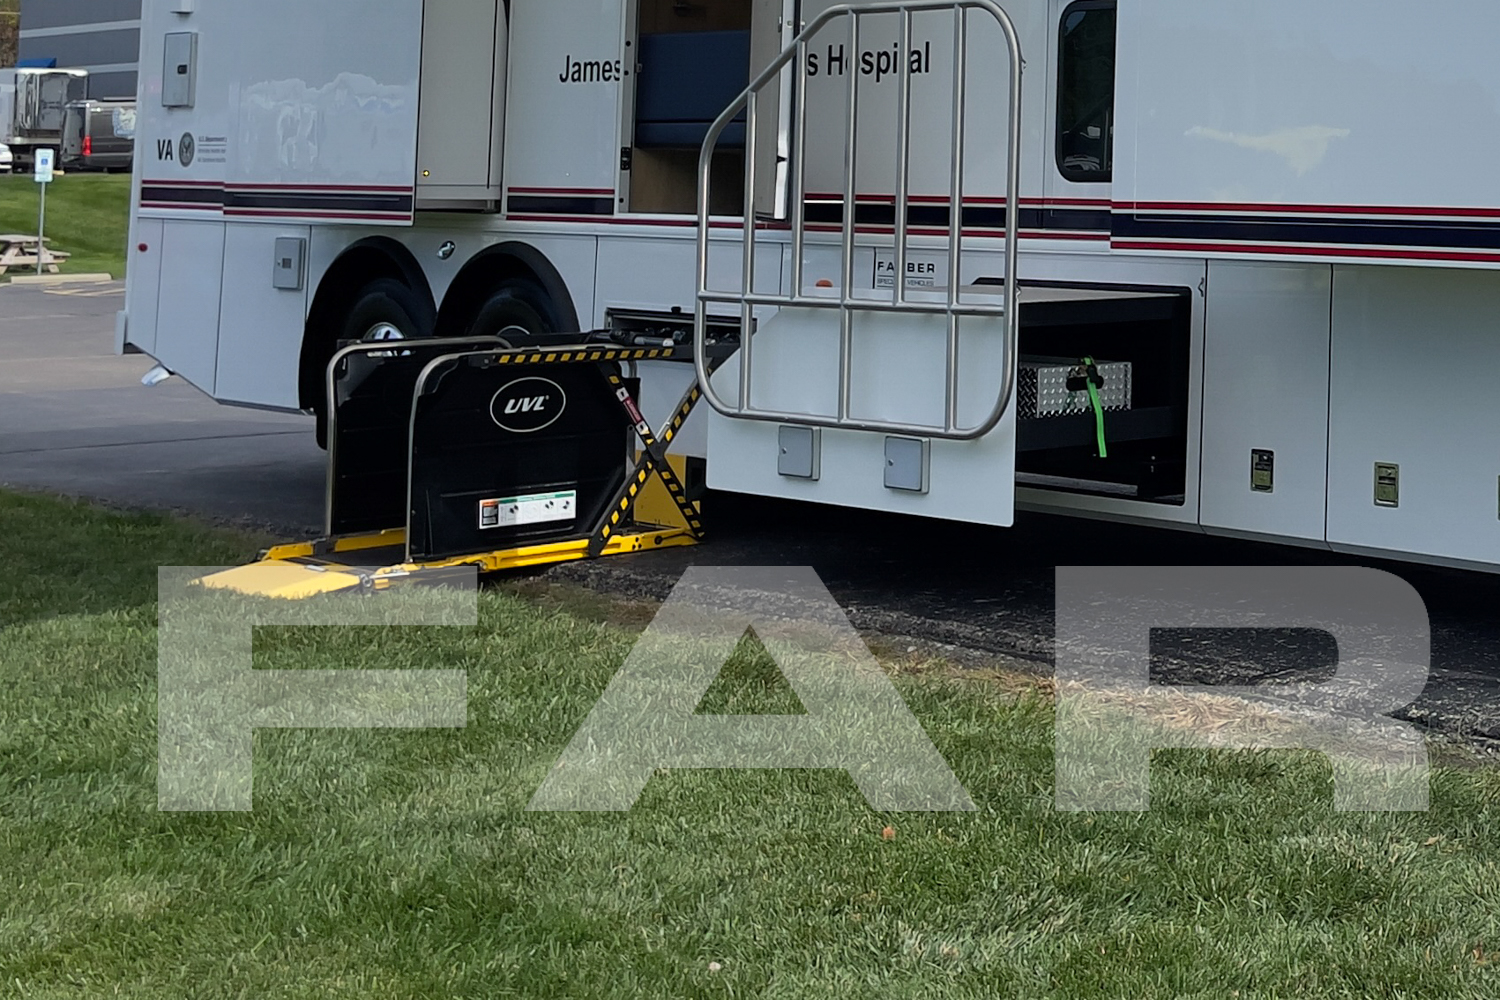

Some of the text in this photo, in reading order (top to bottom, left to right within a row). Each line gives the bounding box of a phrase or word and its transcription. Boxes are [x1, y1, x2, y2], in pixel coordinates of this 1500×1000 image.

[559, 54, 621, 83] James
[827, 41, 930, 83] Hspial
[157, 138, 173, 161] VA
[877, 261, 935, 273] FABER
[504, 395, 545, 414] UVL
